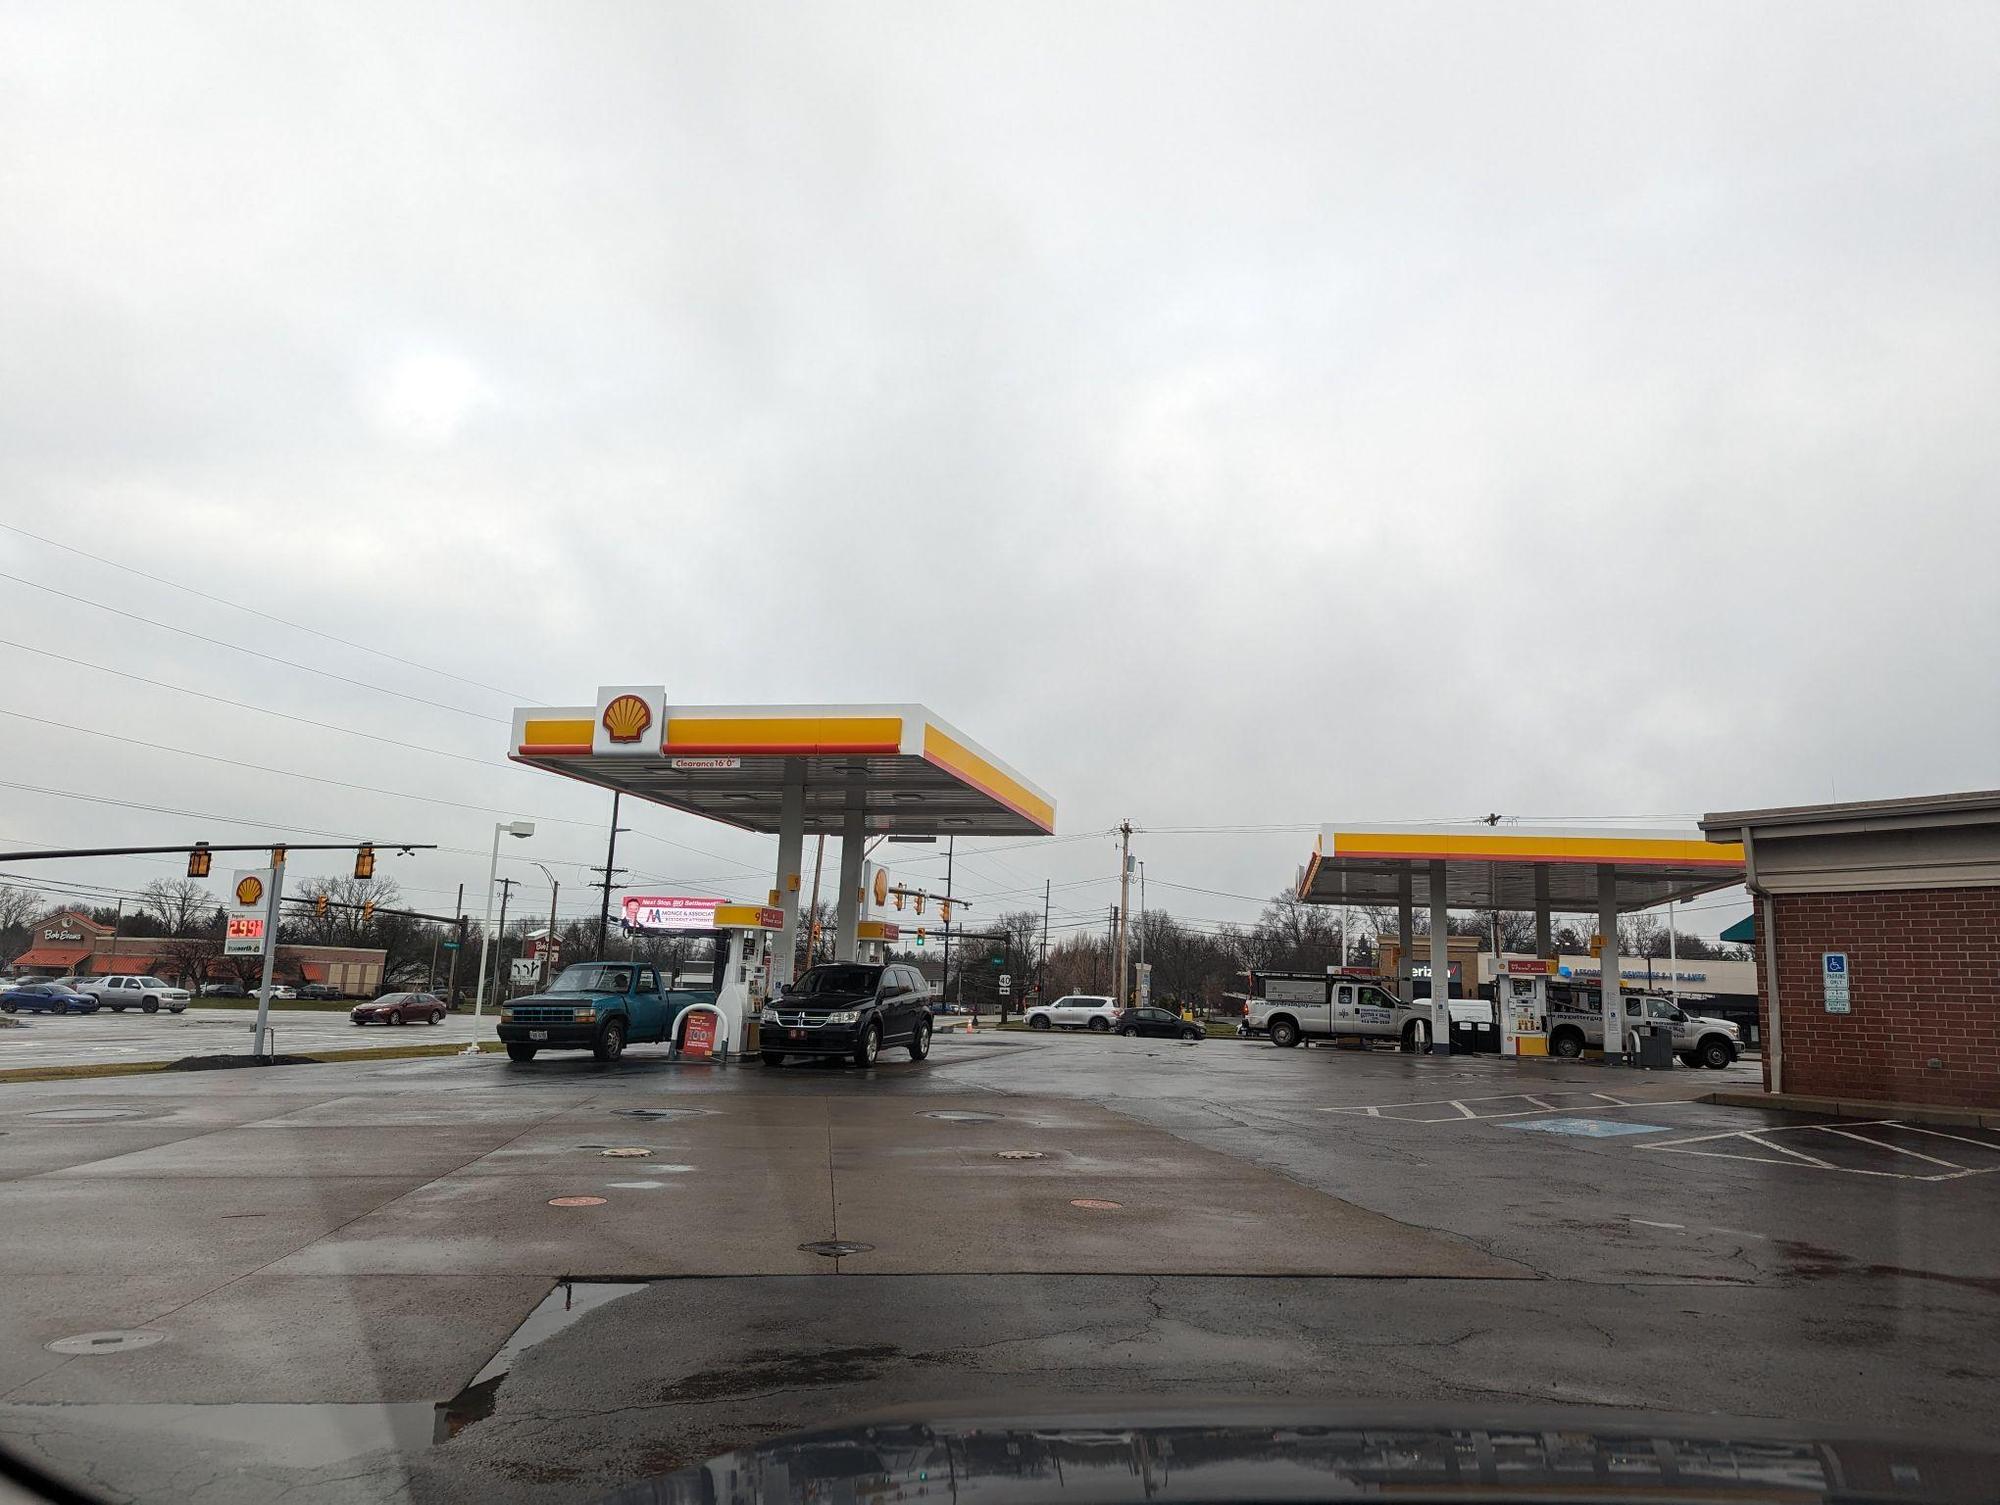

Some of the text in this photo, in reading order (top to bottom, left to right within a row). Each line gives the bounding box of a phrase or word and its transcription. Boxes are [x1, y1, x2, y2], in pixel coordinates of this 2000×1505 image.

[755, 912, 761, 921] 9
[44, 930, 81, 940] Bob Evans
[1000, 977, 1010, 985] 40
